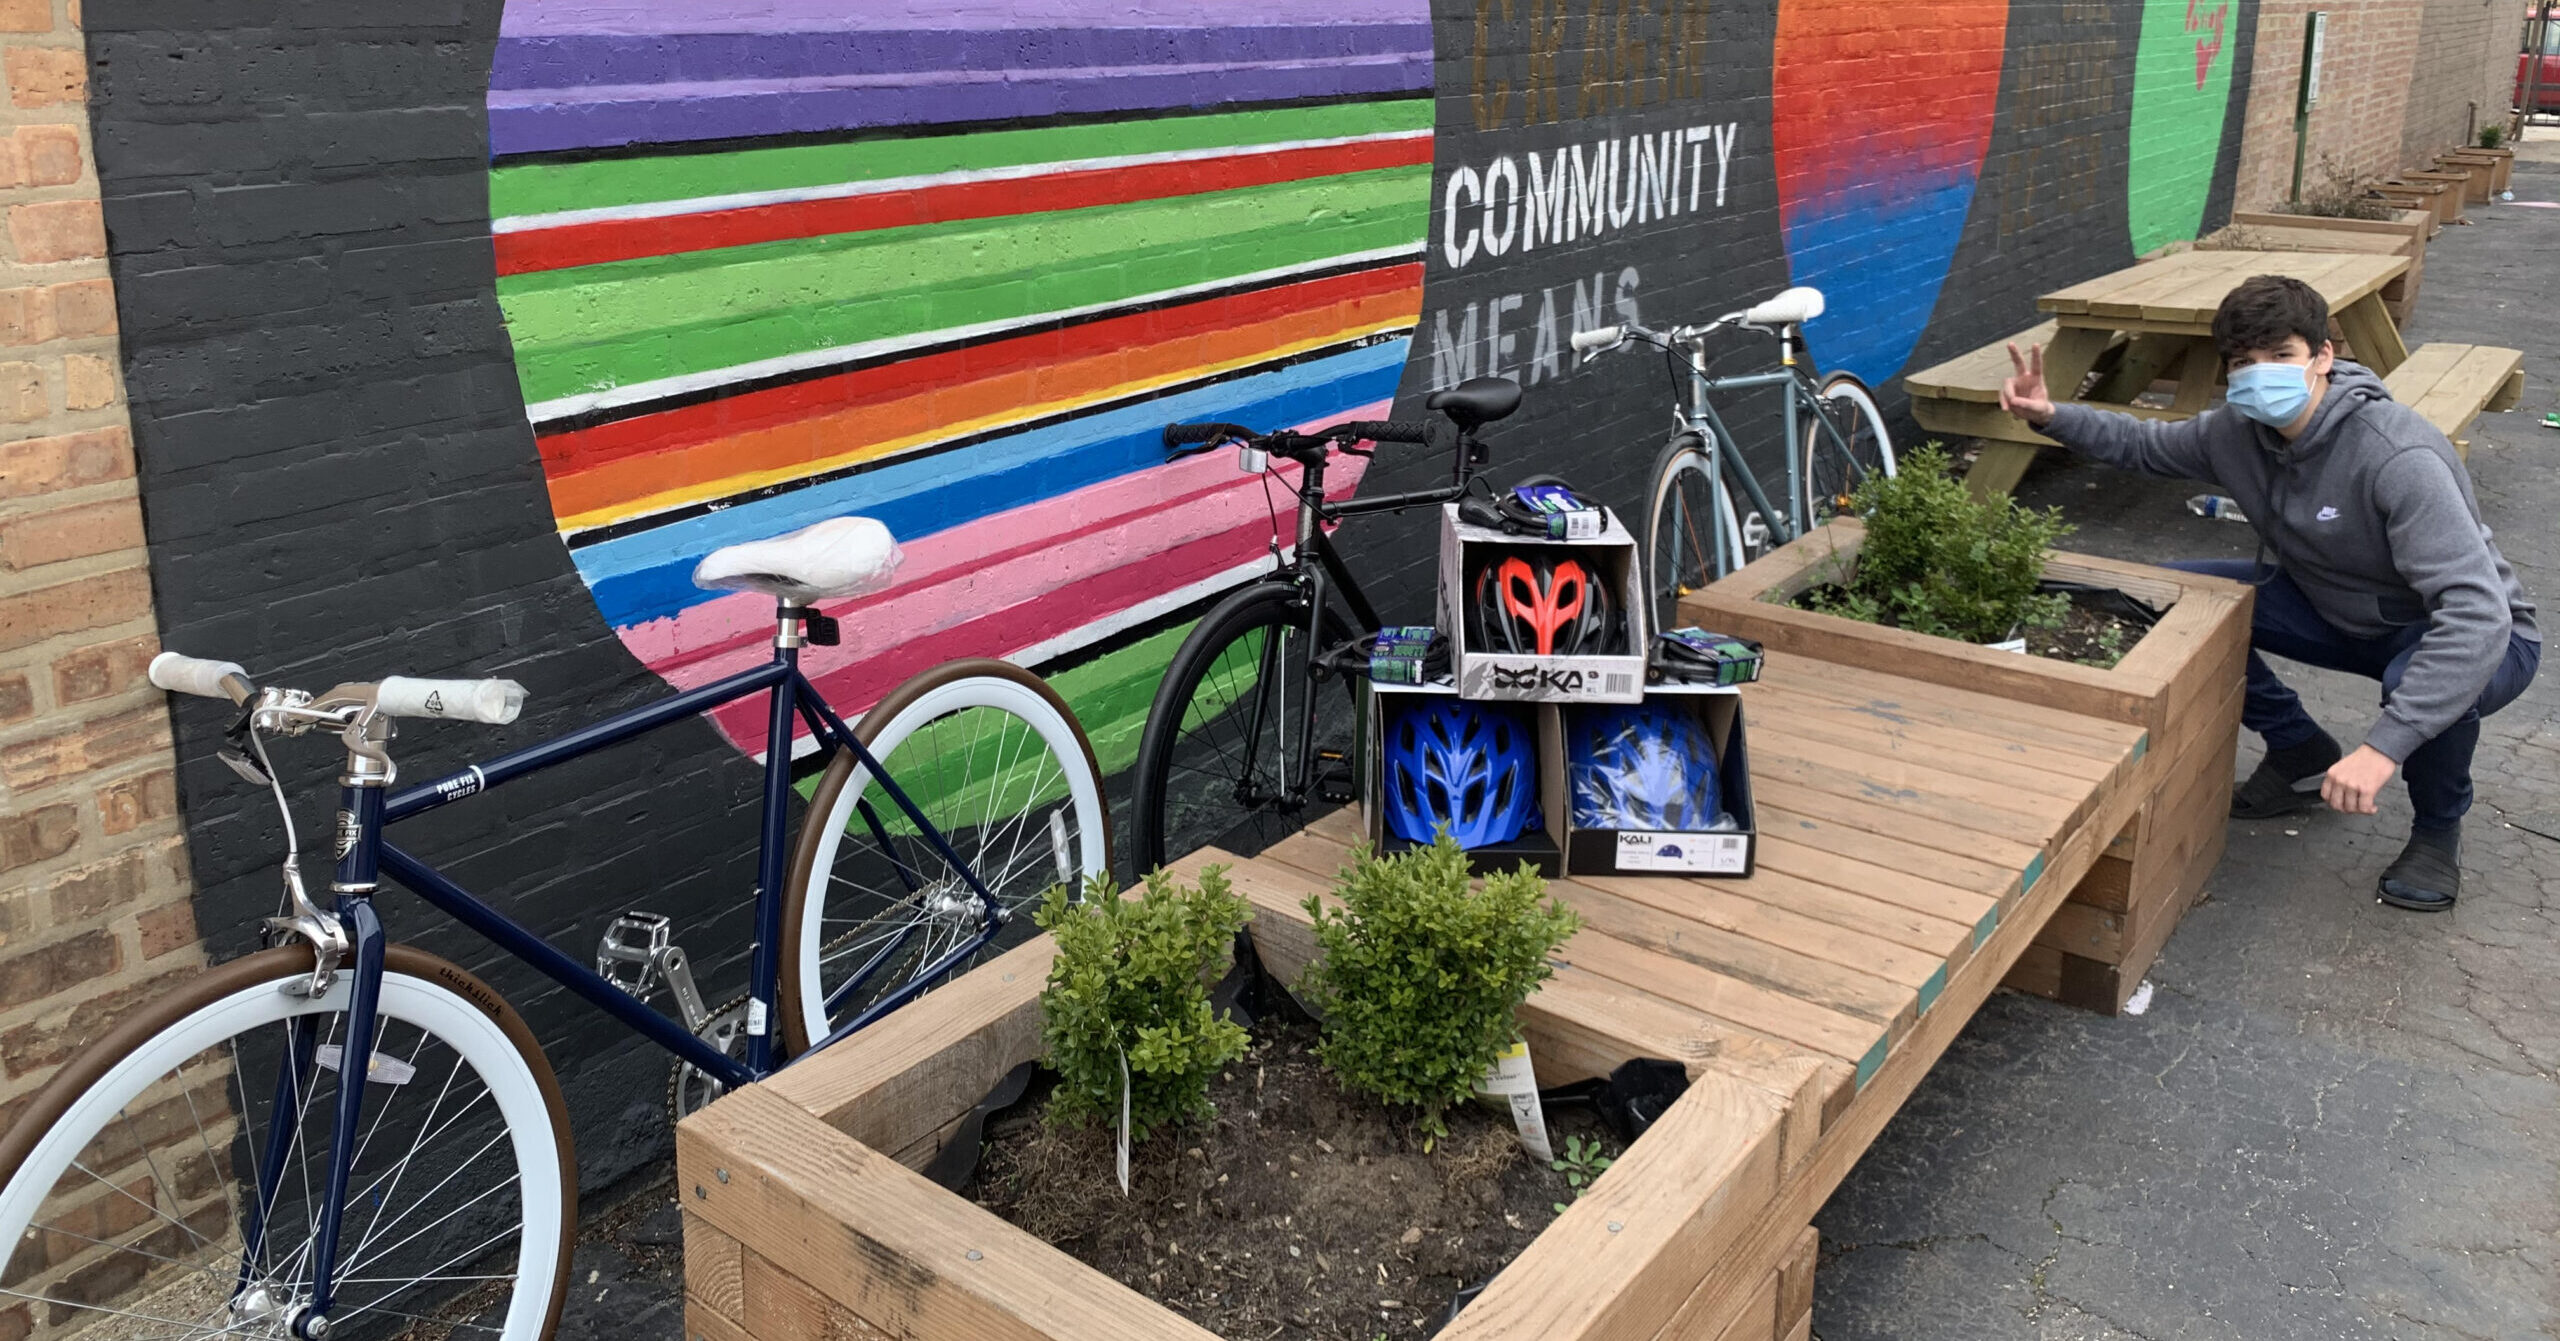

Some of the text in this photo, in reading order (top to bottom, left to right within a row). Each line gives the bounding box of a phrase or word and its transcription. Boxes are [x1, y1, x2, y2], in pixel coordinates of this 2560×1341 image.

[1444, 122, 1737, 269] COMMUNITY
[1432, 266, 1639, 391] MEANS
[436, 774, 475, 795] PURE FIX
[447, 784, 476, 801] CYCLES
[1619, 834, 1652, 845] KALI
[439, 967, 503, 1017] thickslick
